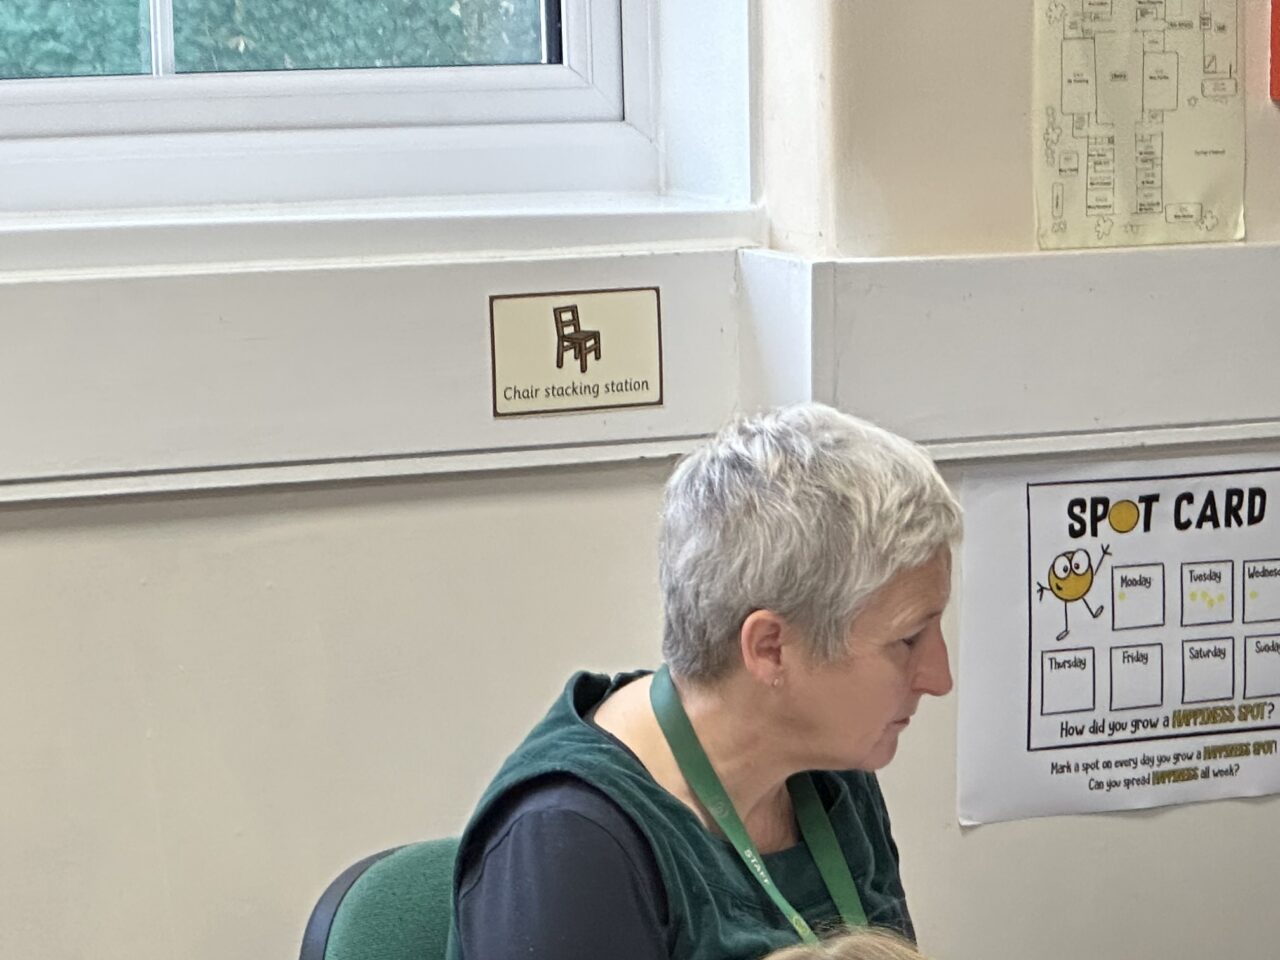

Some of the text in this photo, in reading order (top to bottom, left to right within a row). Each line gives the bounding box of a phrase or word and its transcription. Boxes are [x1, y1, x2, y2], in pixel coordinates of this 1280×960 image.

[503, 377, 650, 402] Chair stacking station
[1067, 487, 1268, 539] SPOT CARD
[1120, 574, 1152, 589] Monday
[1189, 568, 1222, 584] Tuesday
[1122, 650, 1149, 666] Friday
[1189, 646, 1227, 661] Saturday
[1048, 657, 1087, 672] Thursday
[1060, 701, 1275, 739] How did you grow a HAPPINESS SPOT?
[1050, 761, 1072, 775] Mark
[1074, 762, 1080, 773] a
[1081, 759, 1100, 776] spot
[1102, 760, 1113, 770] on
[1114, 757, 1139, 769] every
[1140, 753, 1155, 767] day
[1156, 755, 1171, 767] you
[1173, 751, 1195, 766] grow
[1196, 750, 1202, 760] a
[1088, 777, 1105, 791] Can
[1106, 778, 1122, 792] you
[1123, 772, 1151, 790] spread
[1200, 765, 1211, 779] all
[1212, 763, 1241, 778] week?
